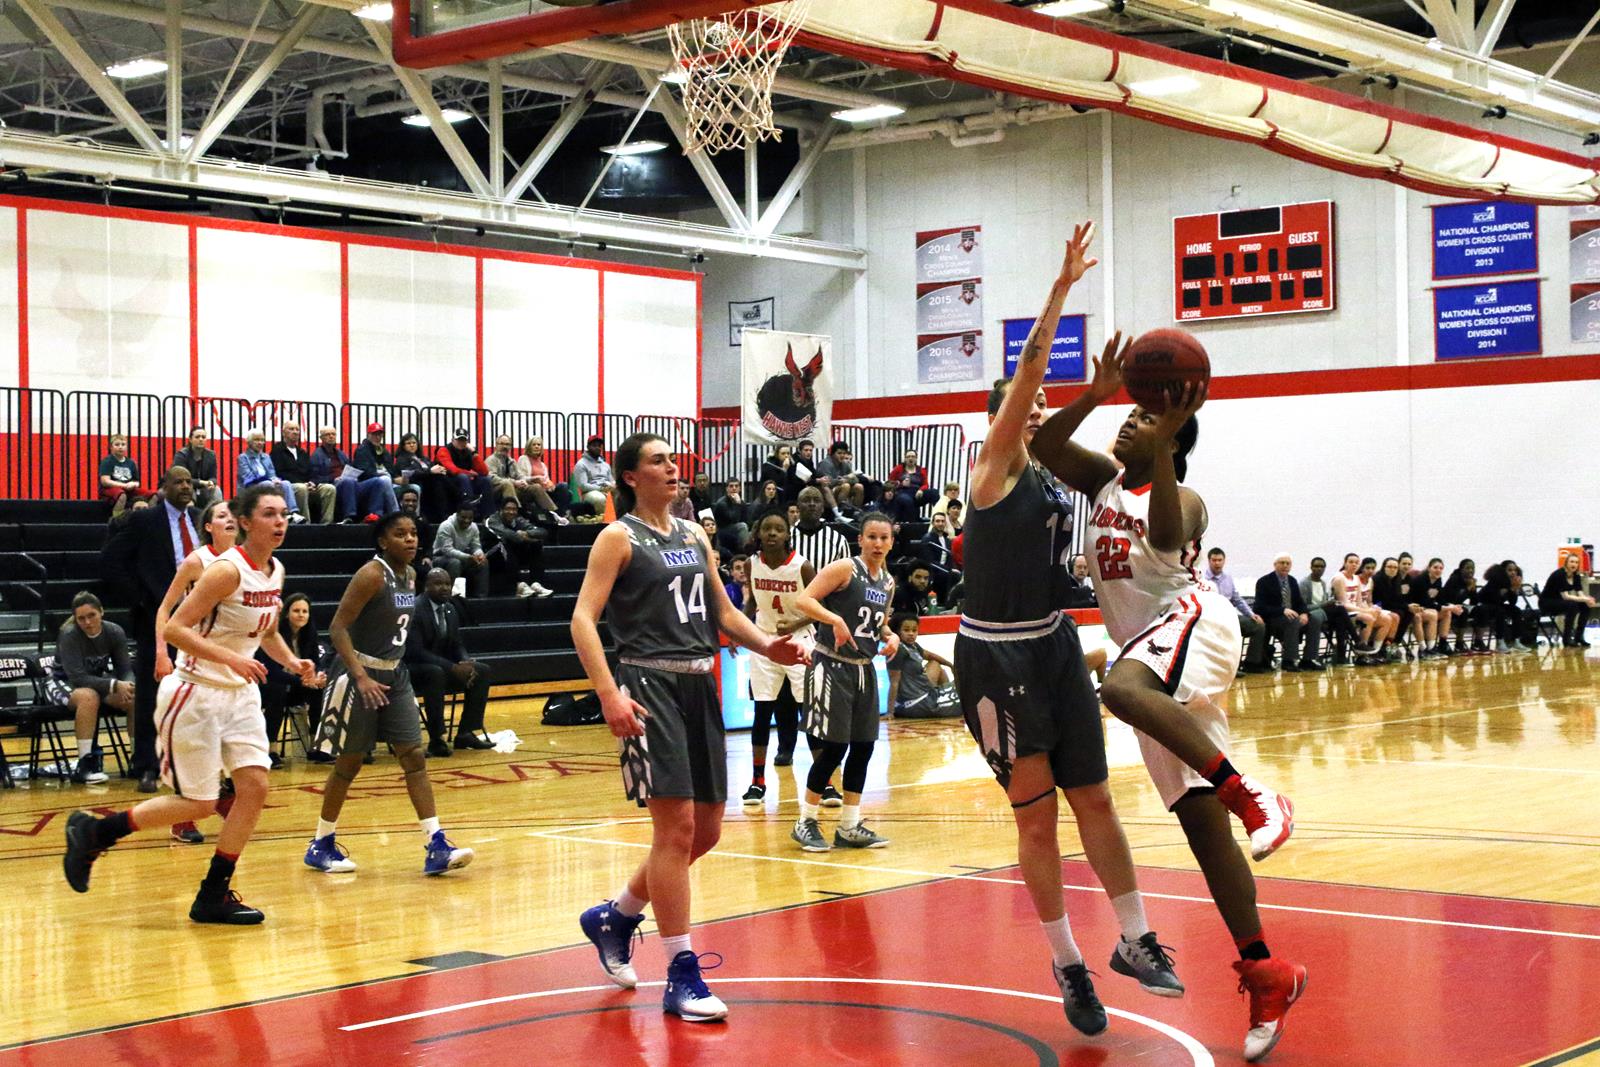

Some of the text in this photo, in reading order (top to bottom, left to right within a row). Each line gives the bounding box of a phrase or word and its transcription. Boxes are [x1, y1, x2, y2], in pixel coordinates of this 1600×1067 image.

[1439, 221, 1530, 237] NATIONAL CHAMPIONS
[1288, 231, 1319, 245] GUEST
[1436, 232, 1534, 248] WOMEN'S CROSS COUNTRY
[928, 244, 951, 254] 2014
[1186, 243, 1212, 255] HOME
[1239, 243, 1262, 252] PERIOD
[1464, 247, 1500, 257] DIVISION
[1475, 258, 1494, 267] 2013
[1230, 274, 1272, 285] PLAYER FOUL
[1302, 270, 1323, 279] FOULS
[1181, 280, 1201, 290] FOULS
[929, 296, 952, 306] 2015
[1302, 299, 1324, 309] SCORE
[1241, 305, 1263, 313] MATCH
[1441, 304, 1533, 319] NATIONAL CHAMPIONS
[1181, 310, 1201, 319] SCORE
[1439, 314, 1537, 329] WOMEN'S CROSS COUNTRY
[1467, 328, 1503, 338] DIVISION
[1052, 336, 1080, 345] MPIONS
[1478, 340, 1497, 349] 2014
[929, 347, 953, 357] 2016
[1050, 351, 1082, 360] COUNTRY
[1096, 535, 1133, 581] 22
[754, 578, 798, 593] ROBERTS
[667, 573, 707, 624] 14
[771, 594, 785, 615] 4
[391, 613, 410, 647] 3
